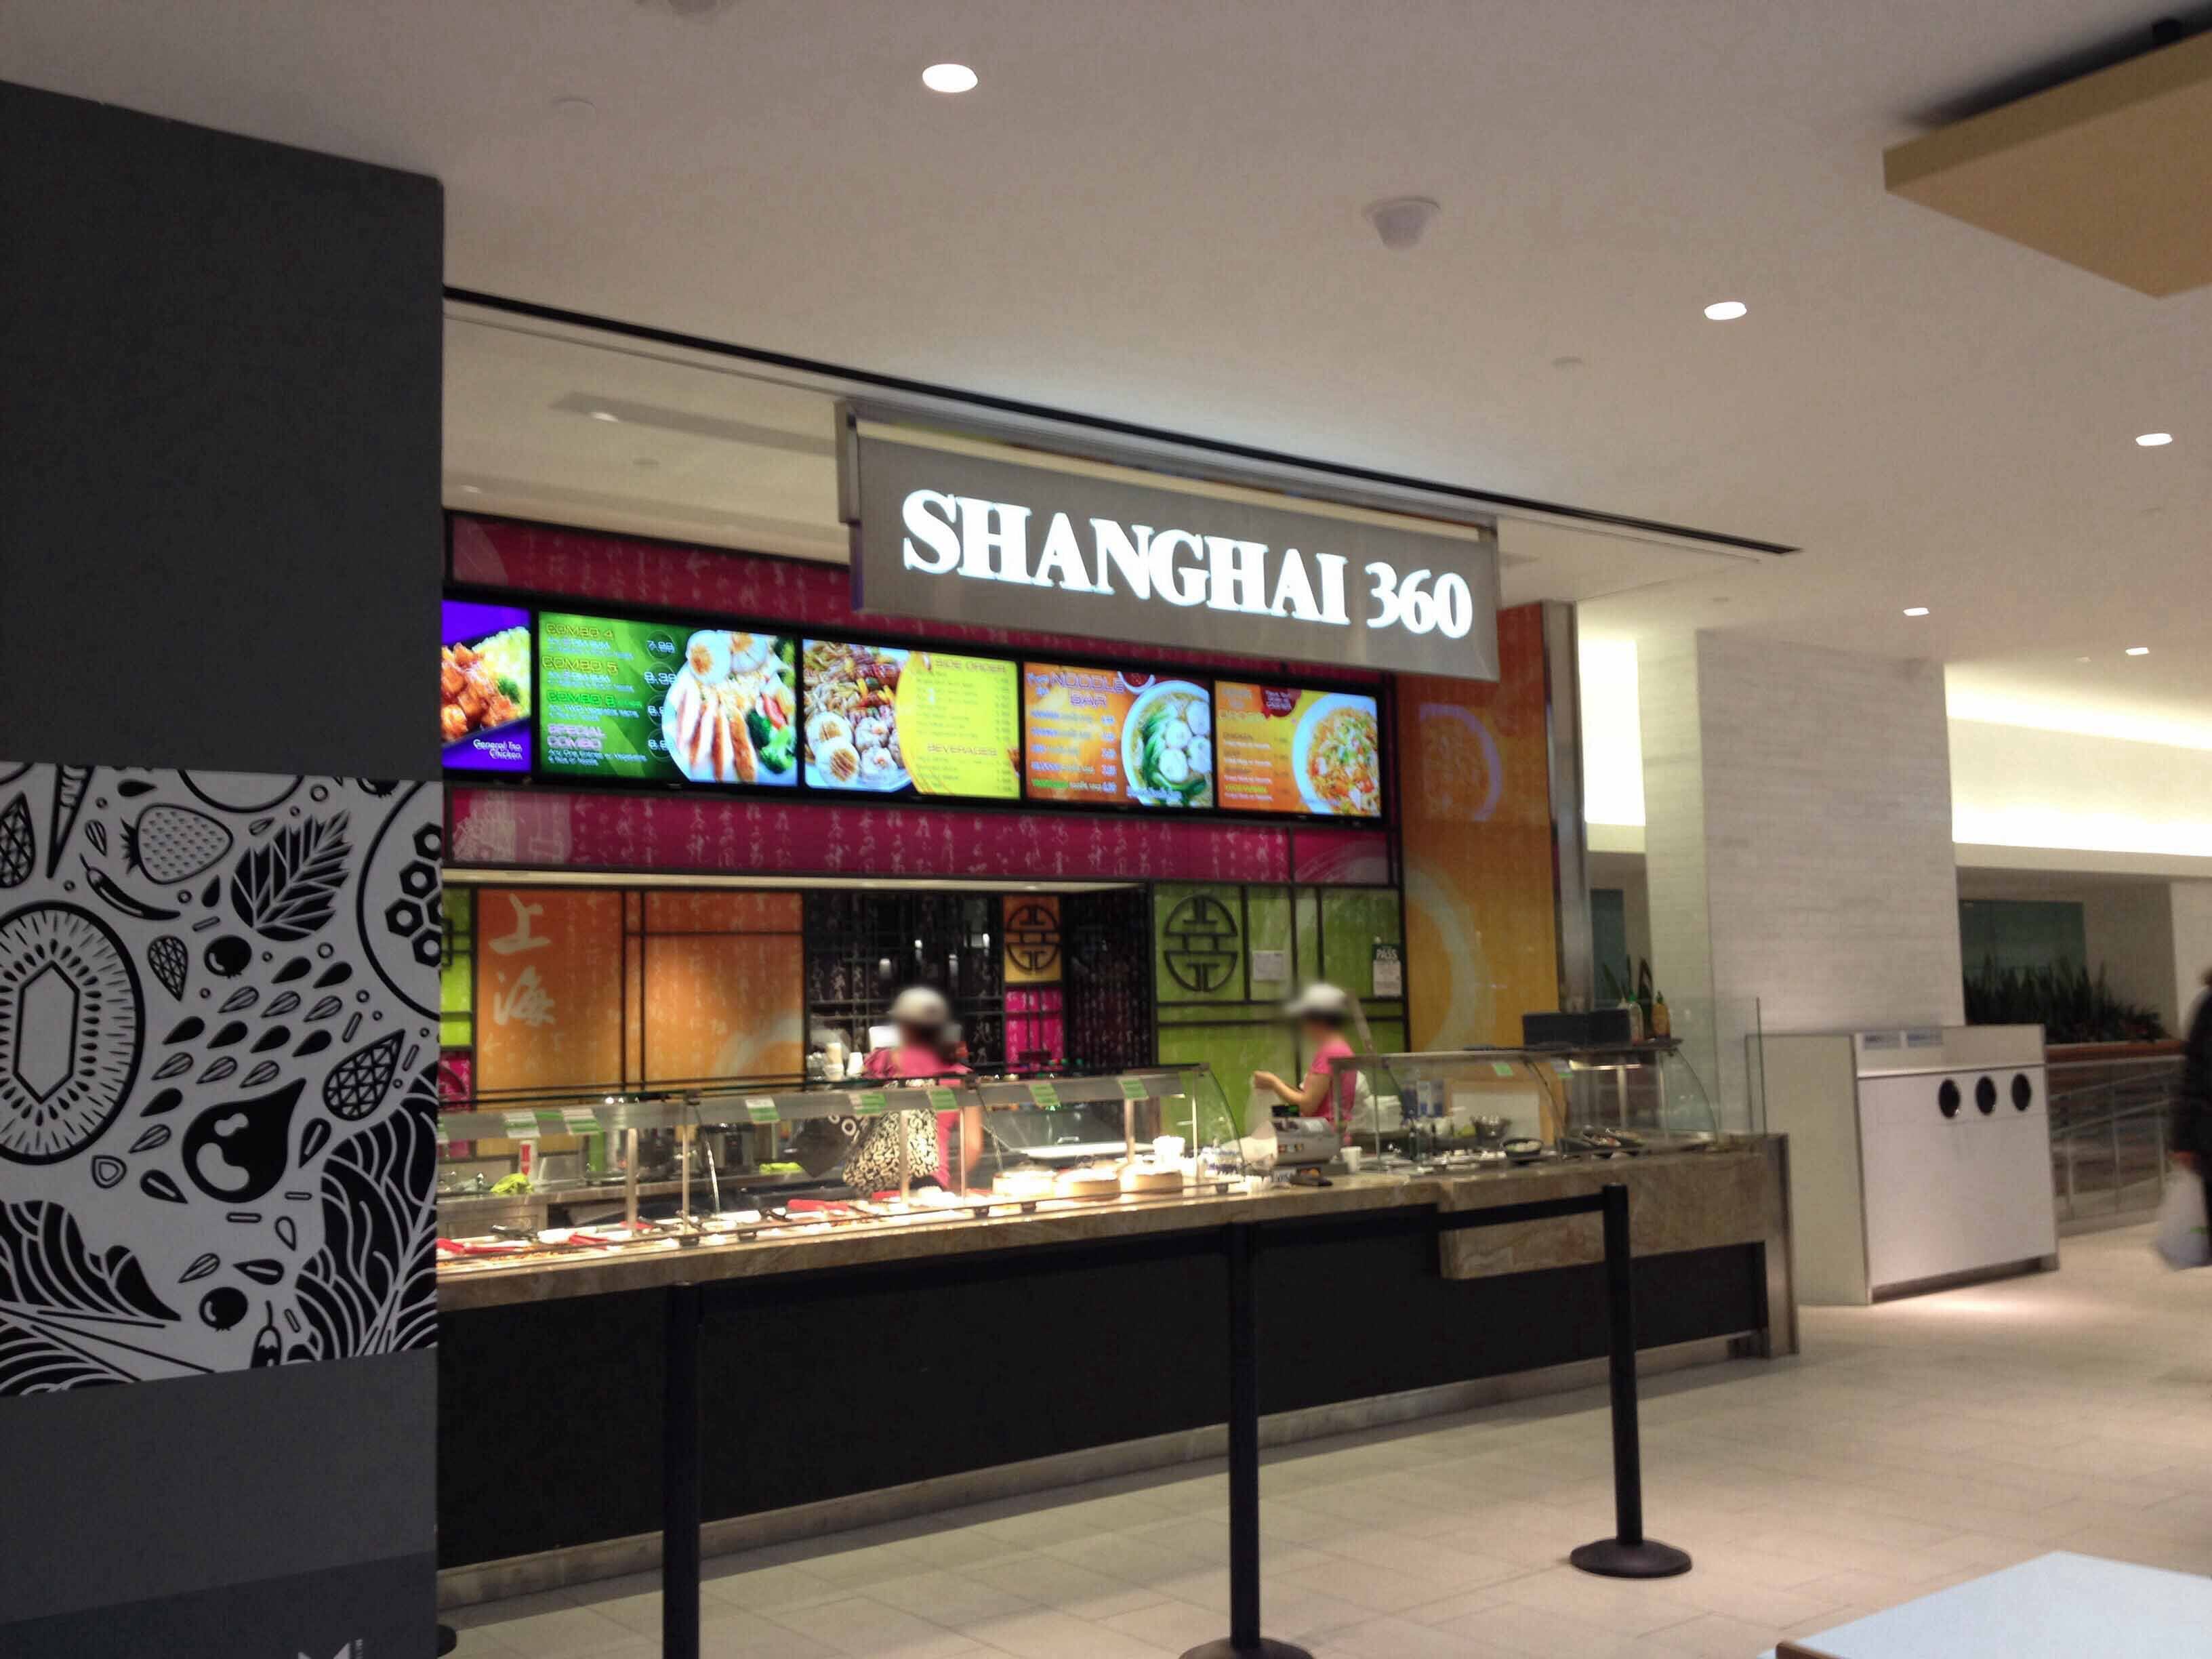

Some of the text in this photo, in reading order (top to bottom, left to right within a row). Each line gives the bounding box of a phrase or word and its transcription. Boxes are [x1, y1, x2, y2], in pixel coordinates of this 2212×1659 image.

[901, 489, 1351, 626] SHANGHAI
[1365, 561, 1474, 639] 360
[546, 623, 600, 638] COMBO
[541, 656, 602, 673] COMBO
[1050, 672, 1125, 694] NOODLE
[1070, 689, 1107, 707] BAR
